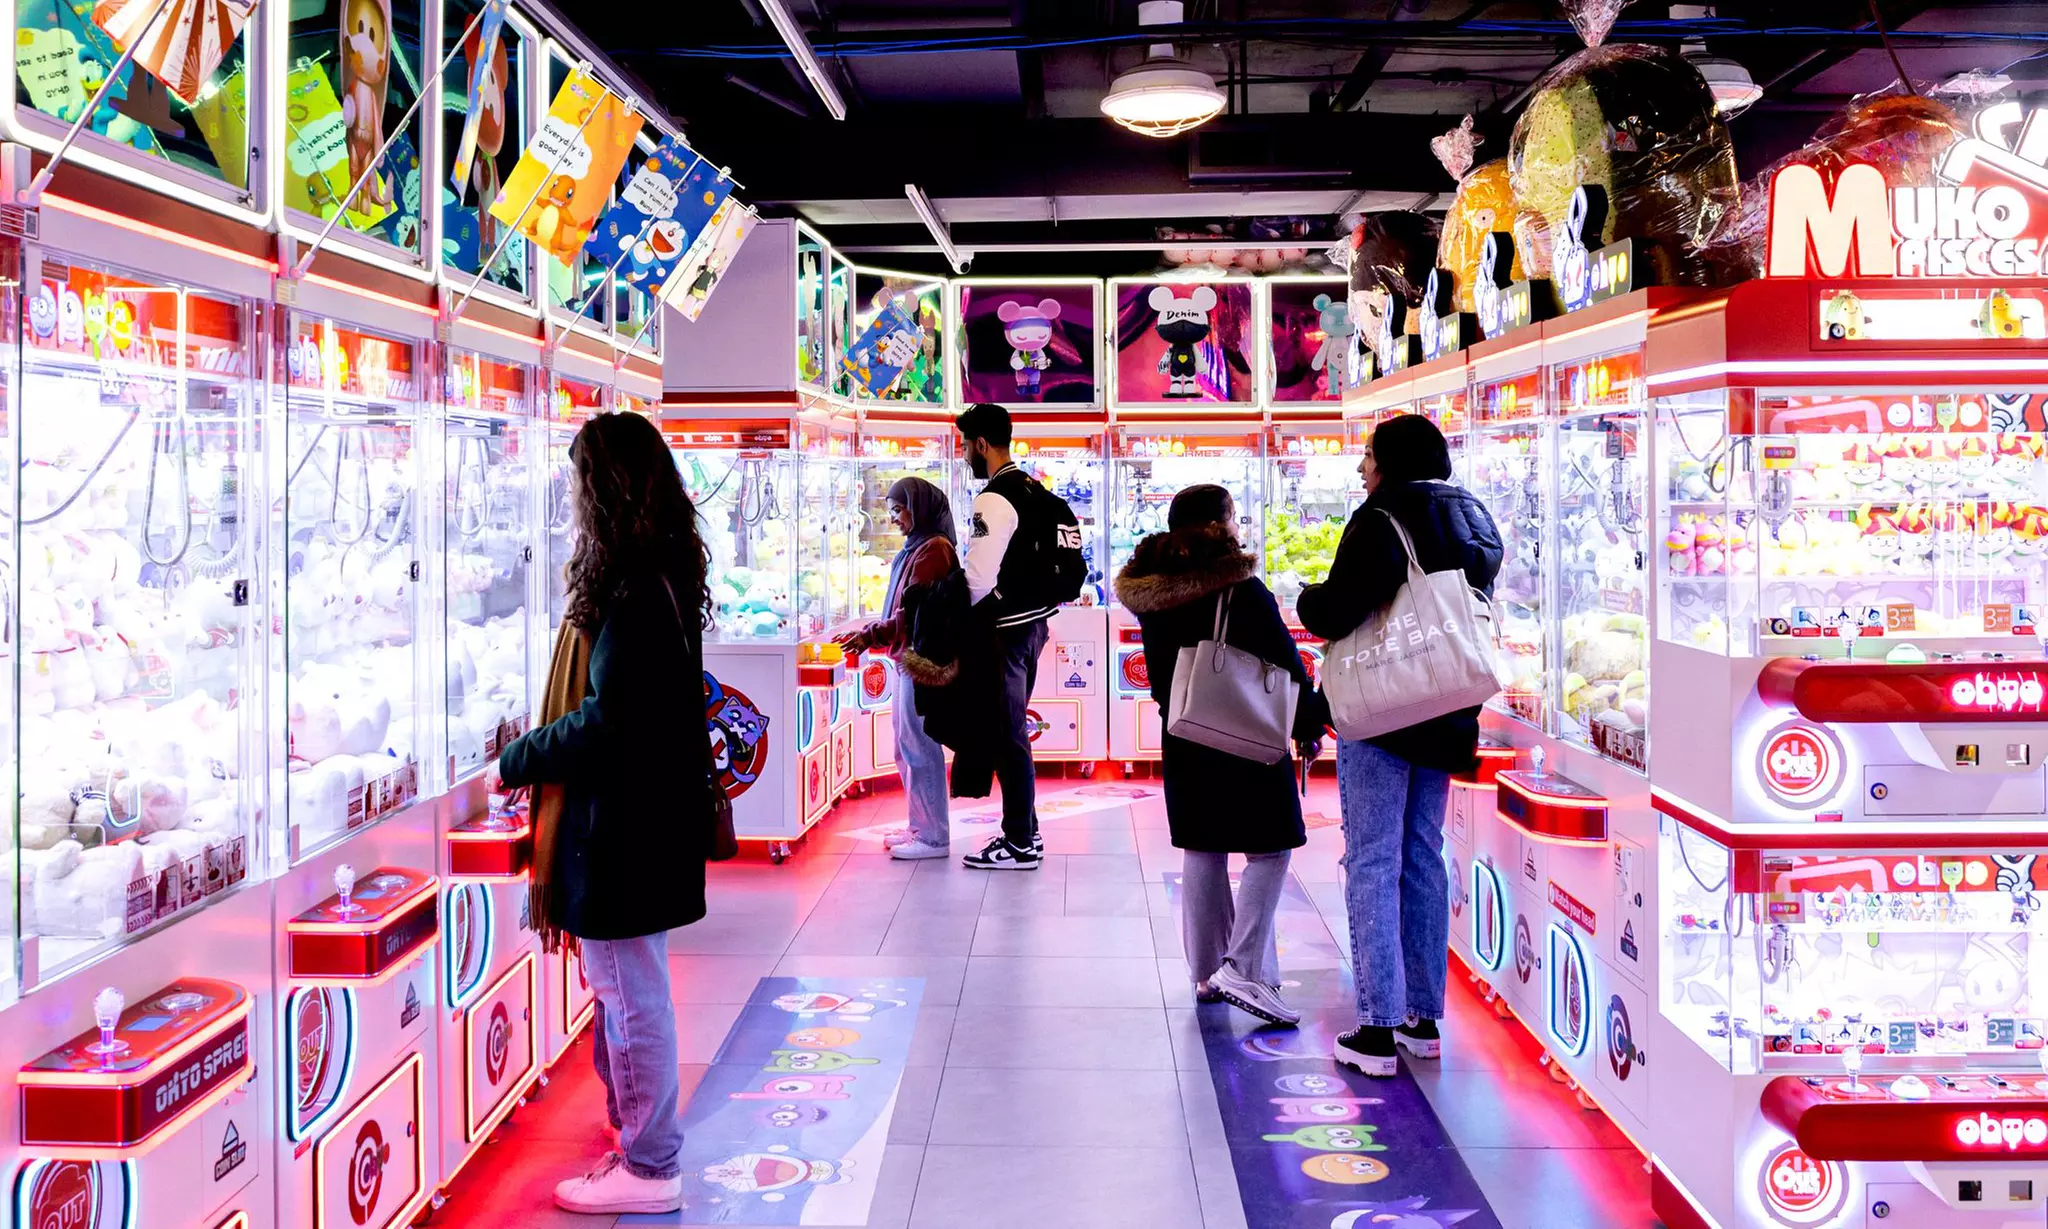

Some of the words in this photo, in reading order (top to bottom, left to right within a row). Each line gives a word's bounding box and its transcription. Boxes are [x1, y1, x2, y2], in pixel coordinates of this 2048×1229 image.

[538, 140, 558, 156] good
[543, 123, 577, 152] Everydy
[633, 182, 648, 196] some
[643, 176, 655, 189] Can
[1767, 164, 2030, 278] MUKO
[1898, 237, 2039, 277] PISCES
[1166, 308, 1200, 321] Denim
[1057, 524, 1082, 549] ANS
[1375, 612, 1417, 641] THE
[1340, 637, 1400, 669] TOTE
[1407, 619, 1459, 647] BAG
[1365, 658, 1395, 671] MARC
[1952, 672, 2043, 711] obyo
[1890, 1024, 1901, 1045] 3
[1988, 1021, 2000, 1042] 3
[1956, 1112, 2048, 1150] obyo
